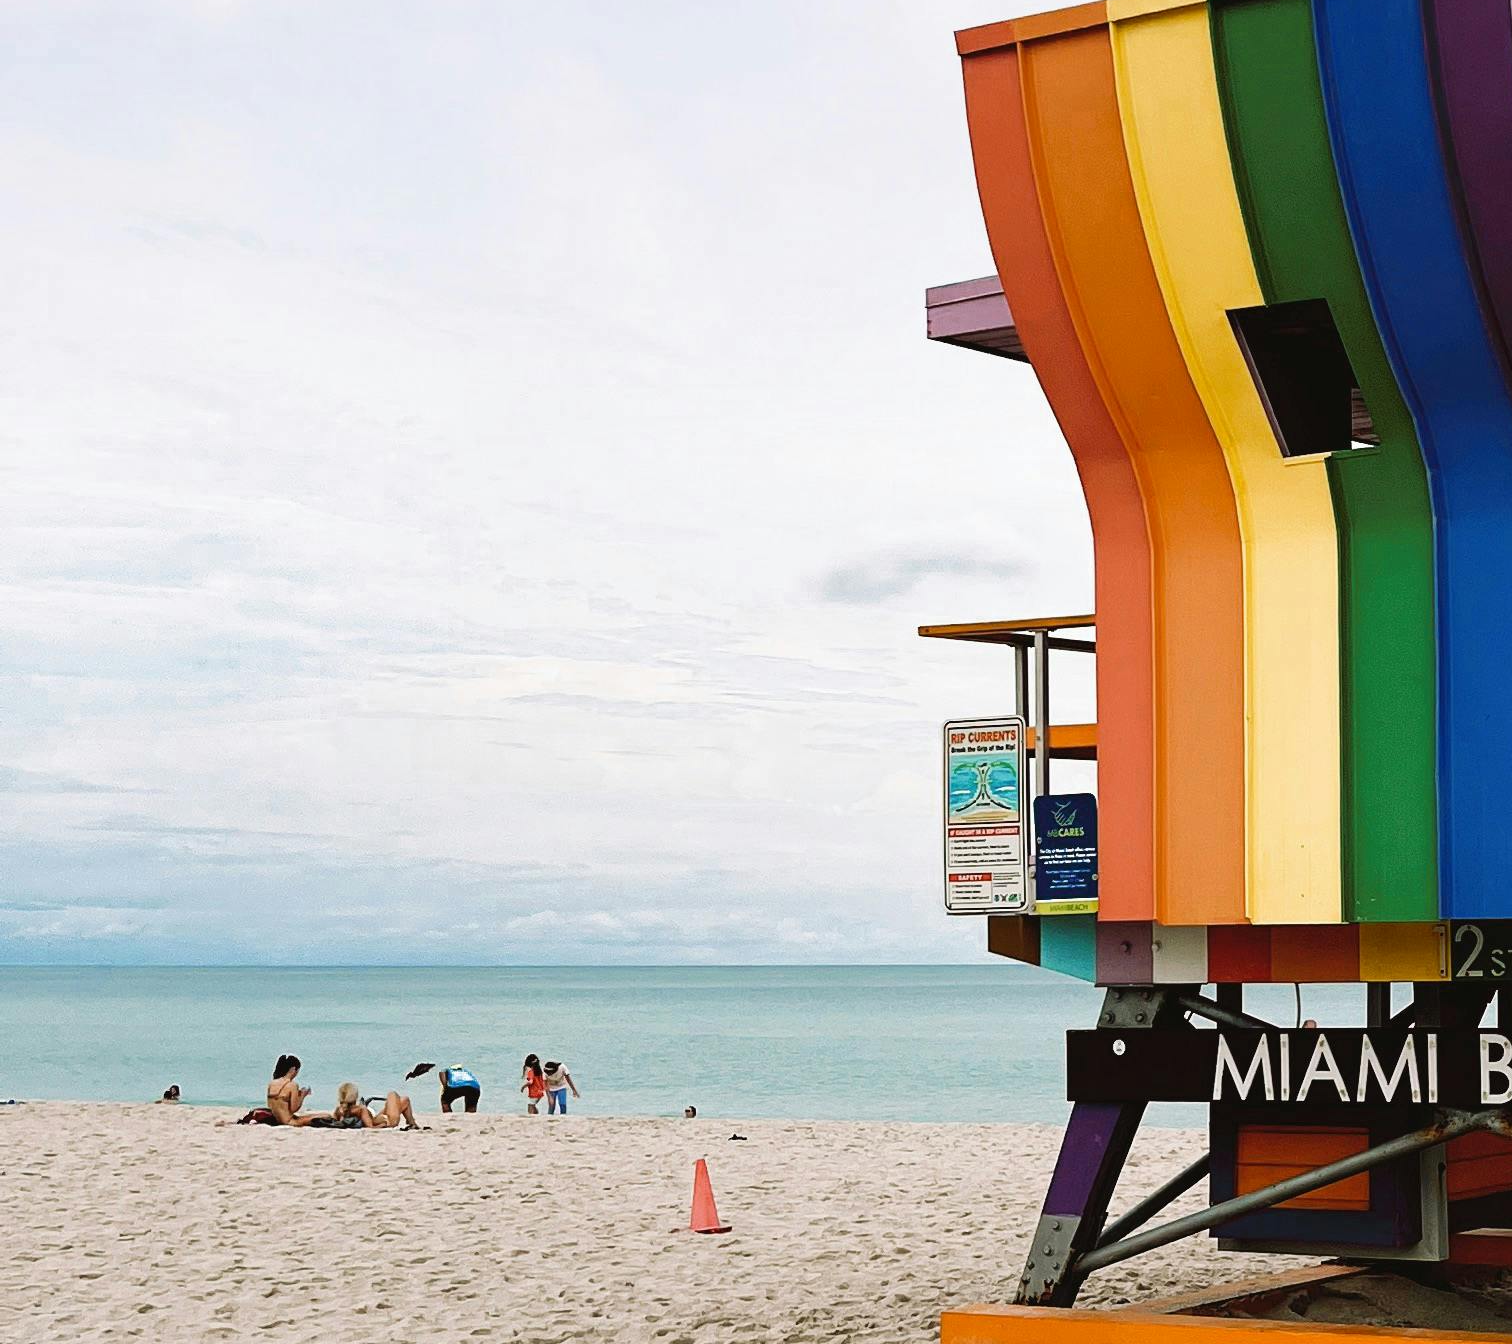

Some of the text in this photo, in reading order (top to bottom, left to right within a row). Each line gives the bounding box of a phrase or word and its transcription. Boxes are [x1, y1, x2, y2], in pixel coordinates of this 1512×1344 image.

[951, 730, 1016, 744] RIP CURRENTS
[1213, 1032, 1438, 1103] MIAMI
